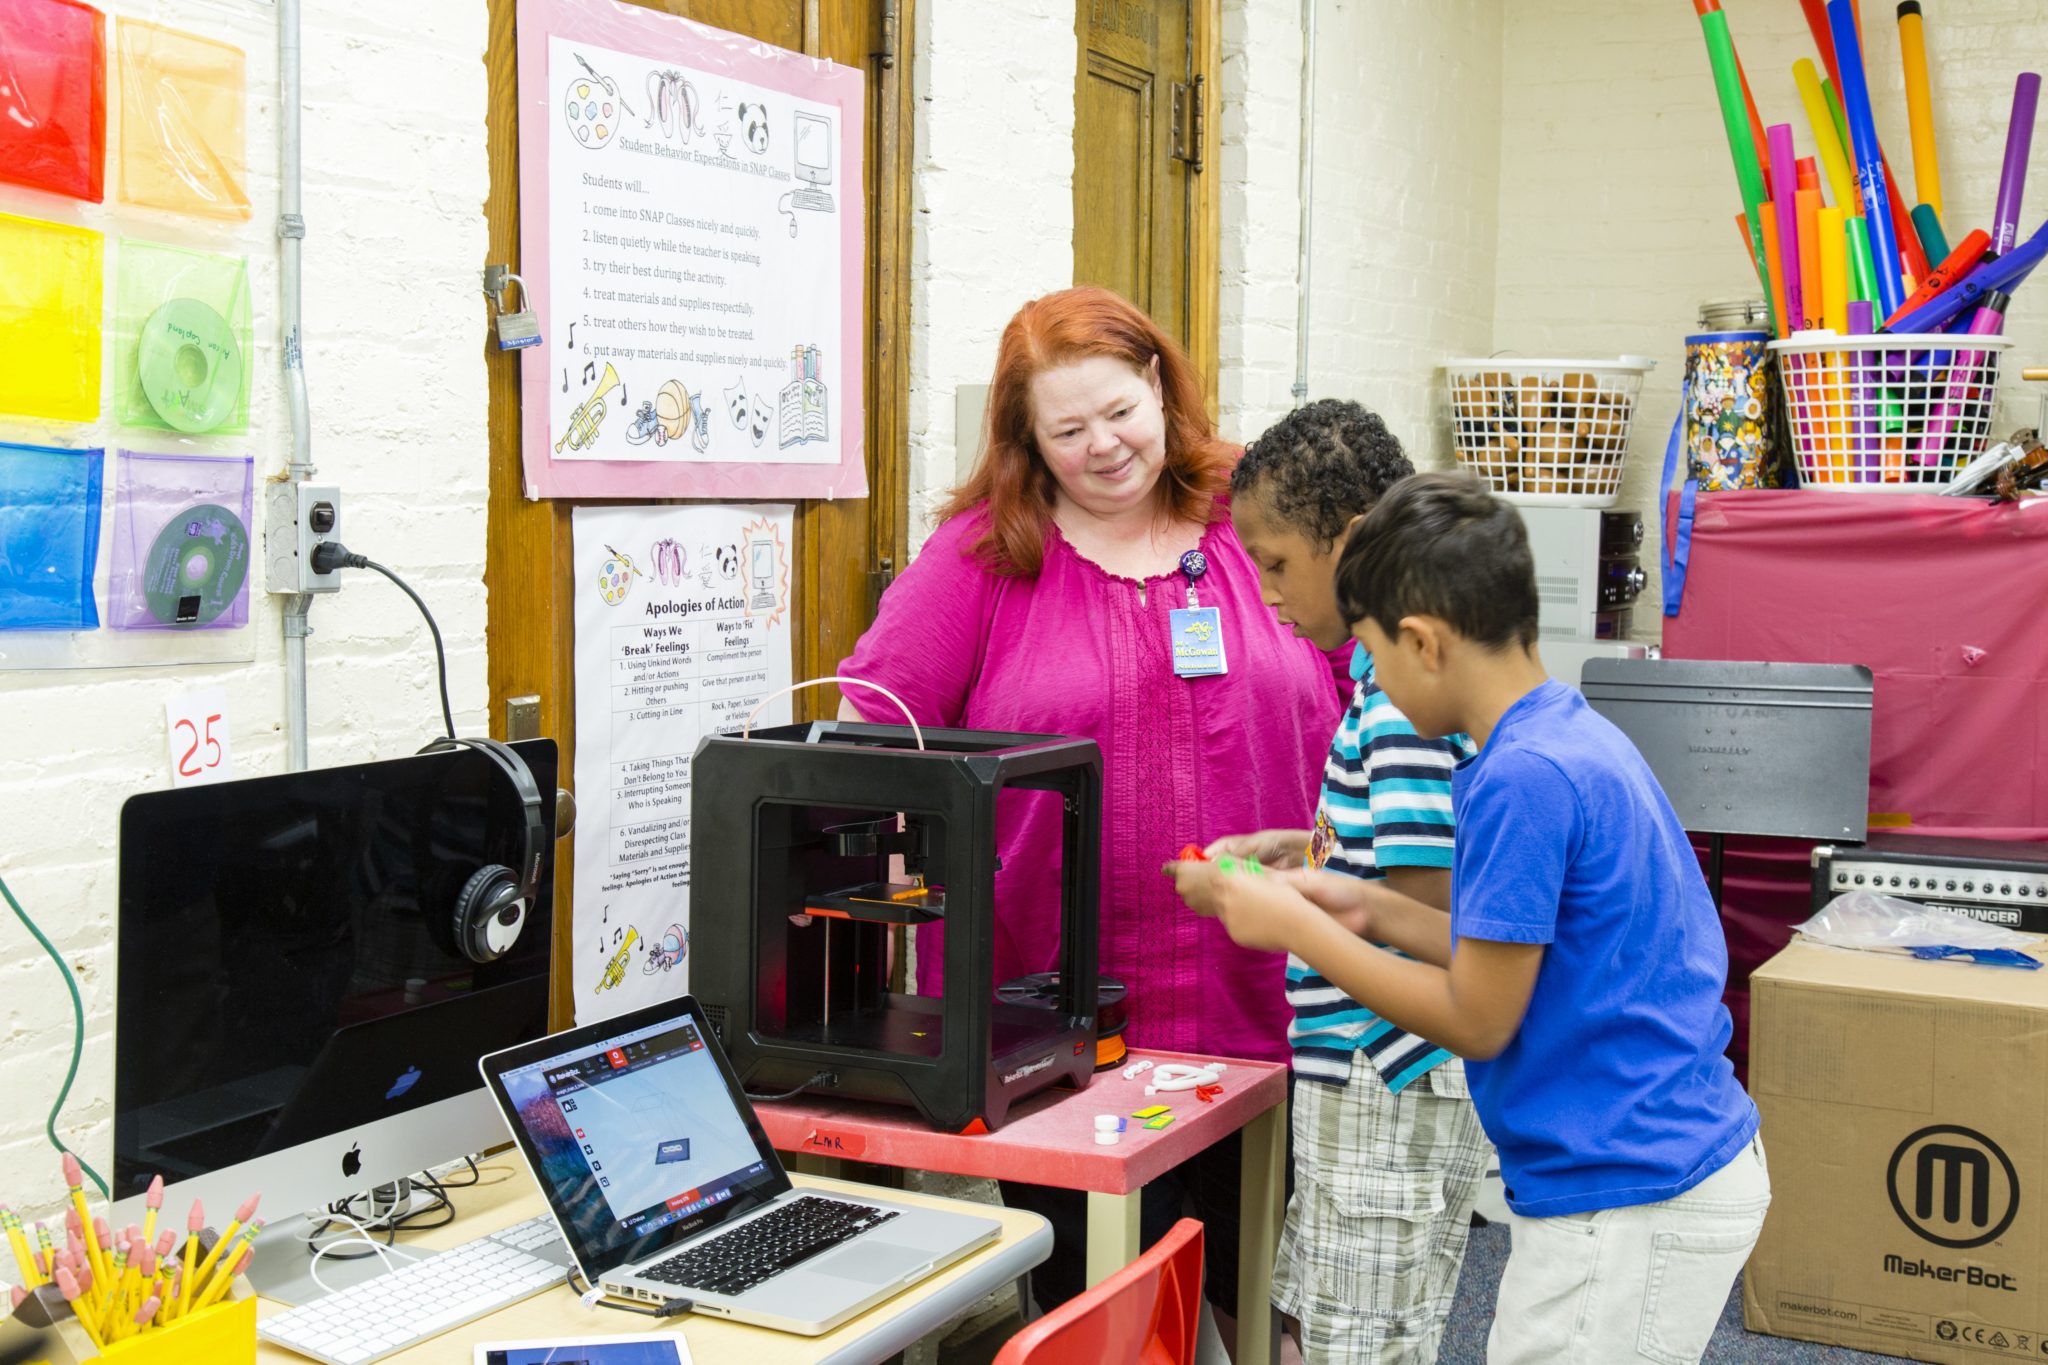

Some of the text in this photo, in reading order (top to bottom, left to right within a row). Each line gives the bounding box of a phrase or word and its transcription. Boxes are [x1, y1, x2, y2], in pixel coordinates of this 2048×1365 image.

[620, 137, 790, 181] Student Behavior Expectations in SNAP Classes
[582, 173, 650, 194] Students will...
[584, 202, 760, 239] 1. come into SNAP Classes nicely and quickly.
[583, 229, 762, 267] 2. listen quietly while the teacher is speaking.
[583, 258, 727, 288] 3. try their best during the activity.
[583, 287, 755, 316] 4. treat materials and supplies respectfully.
[583, 315, 754, 340] 5. treat others how they wish to be treated.
[584, 343, 788, 370] 6. put away materials and supplies nicely and quickly.
[646, 596, 745, 618] Apologies of Action
[644, 626, 682, 640] Ways We
[716, 622, 734, 634] Ways
[735, 621, 741, 631] to
[656, 642, 689, 654] Feelings
[724, 636, 749, 647] Feelings
[620, 656, 692, 671] 1. Using Unkind Words
[707, 651, 739, 664] Compliment
[748, 649, 762, 660] person
[634, 669, 679, 682] and/or Actions
[702, 677, 715, 687] Give
[716, 675, 727, 685] that
[728, 676, 744, 687] person
[758, 672, 766, 682] hug
[624, 688, 630, 696] 2.
[632, 685, 653, 696] Hitting
[663, 682, 689, 693] pushing
[645, 696, 666, 706] Others
[712, 697, 759, 711] Rock, Paper, Scissors
[637, 710, 660, 721] Cutting
[662, 709, 668, 717] in
[670, 707, 683, 716] Line
[732, 723, 746, 732] anothe
[174, 713, 222, 777] 25
[630, 763, 650, 772] Taking
[651, 759, 673, 769] Things
[675, 756, 689, 765] That
[643, 772, 665, 782] Belong
[624, 785, 663, 798] Interrupting
[665, 781, 690, 790] Someon
[628, 795, 682, 810] Who is Speaking
[628, 821, 666, 835] Vandalizing
[625, 832, 686, 848] Disrespecting Class
[619, 848, 648, 863] Materials
[651, 848, 662, 856] and
[626, 876, 651, 888] Apologies
[660, 873, 677, 881] Action
[1884, 1254, 2017, 1292] MakerBot
[1780, 1300, 1858, 1320] makerbot.com
